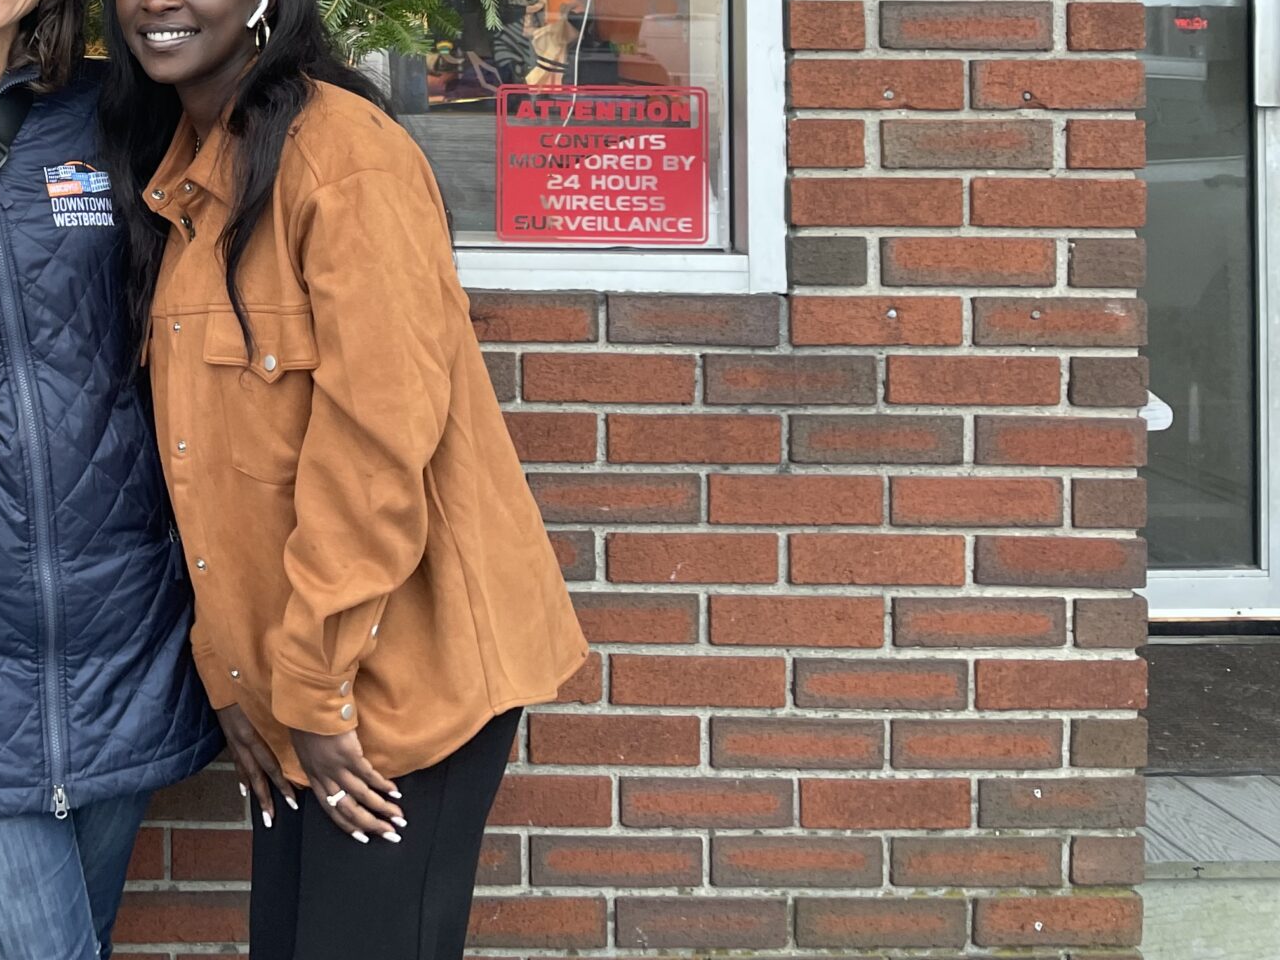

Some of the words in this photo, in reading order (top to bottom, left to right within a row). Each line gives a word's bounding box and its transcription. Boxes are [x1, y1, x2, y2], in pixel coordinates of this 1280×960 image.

[515, 100, 691, 122] ATTENTION
[539, 133, 667, 150] CONTENTS
[509, 153, 651, 171] MONITORED
[662, 155, 696, 171] BY
[546, 174, 581, 190] 24
[591, 174, 658, 191] HOUR
[51, 197, 113, 213] DOWNTOWN
[539, 194, 667, 212] WIRELESS
[53, 212, 115, 227] WESTBROOK
[514, 215, 693, 233] SURVEILLANCE
